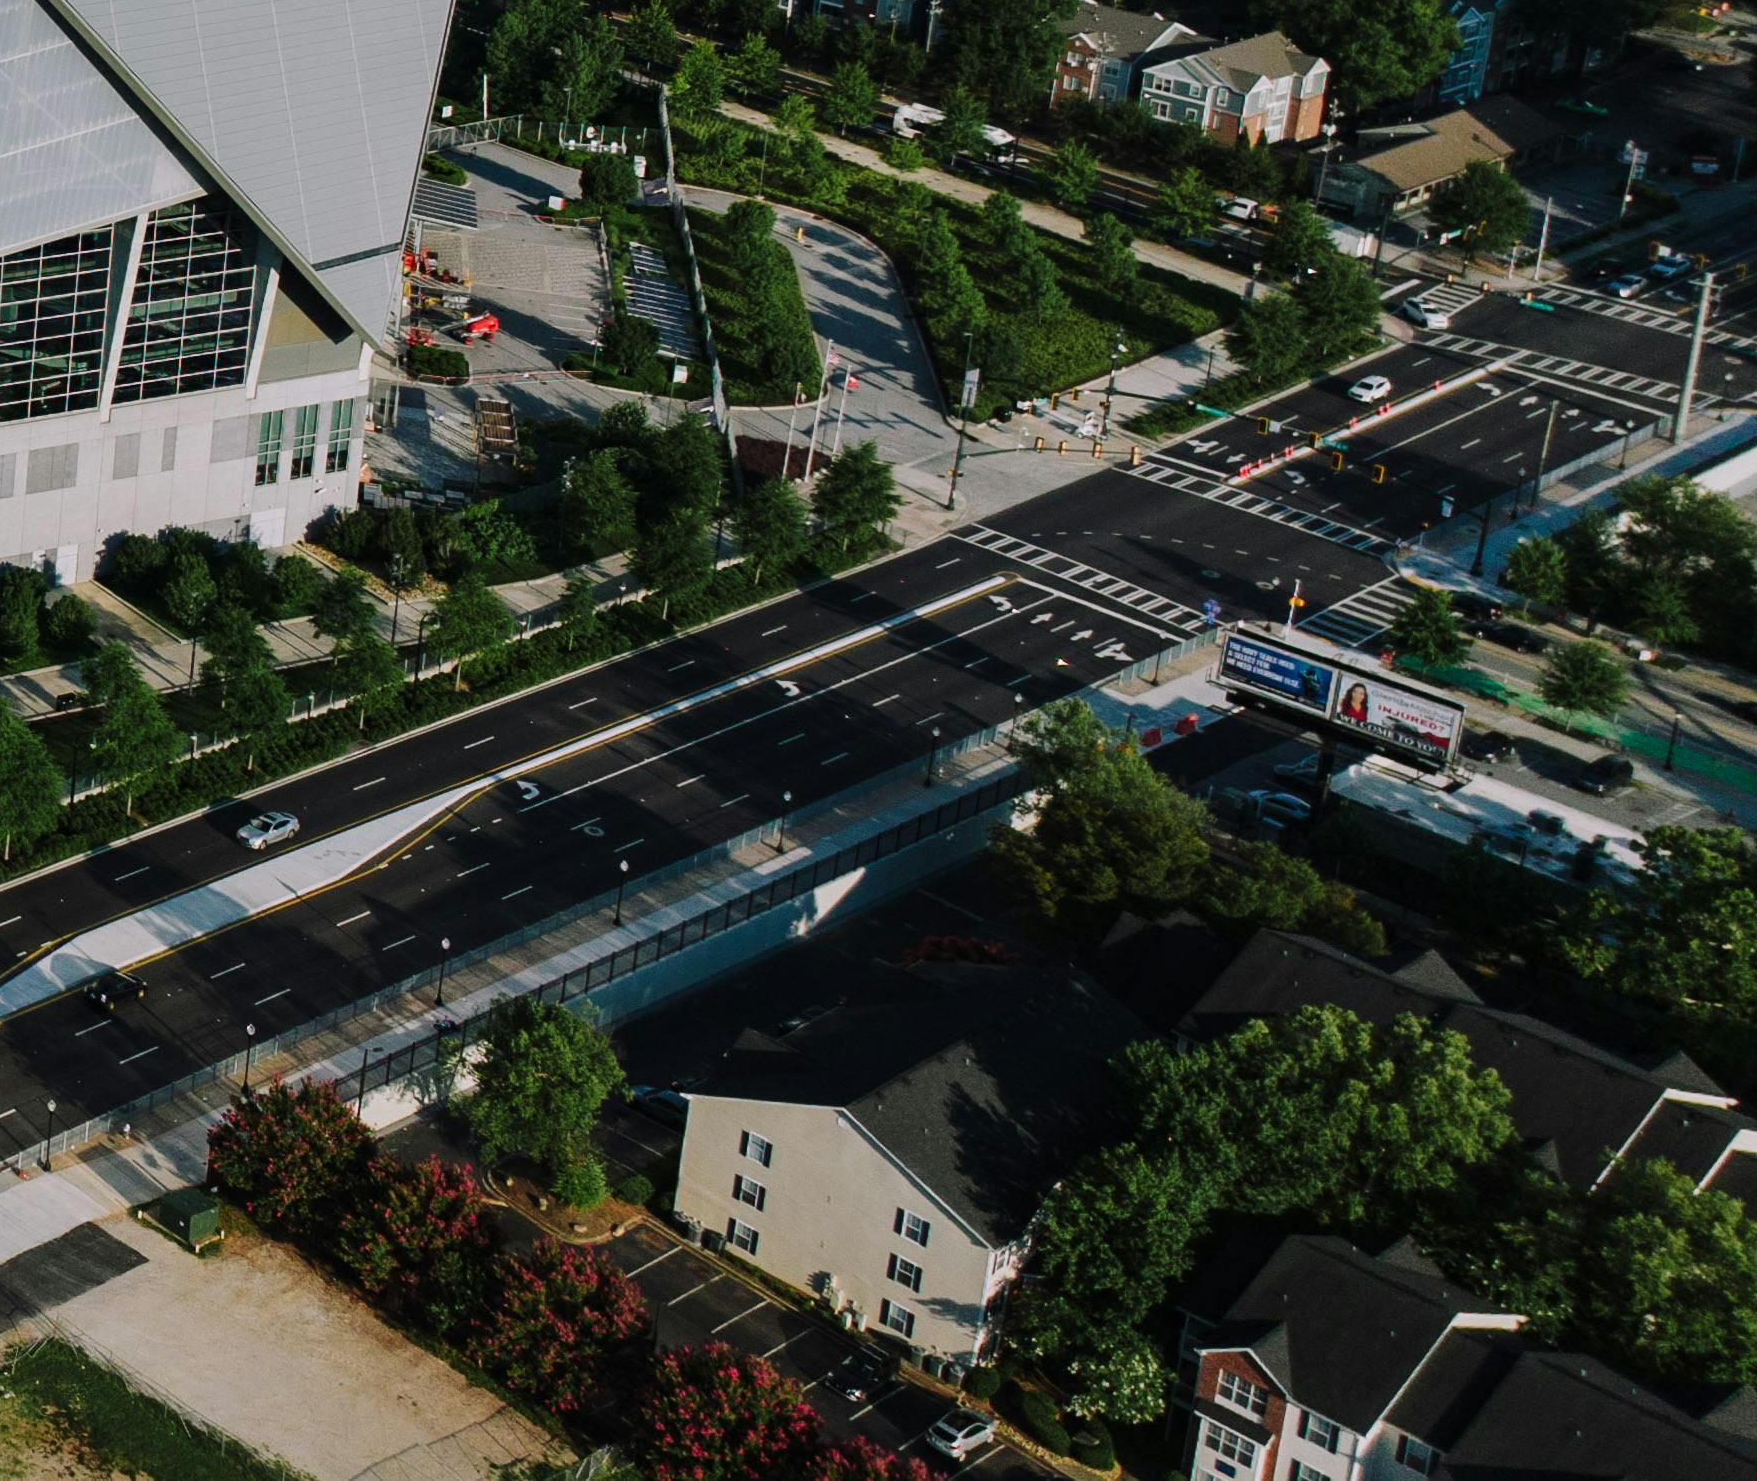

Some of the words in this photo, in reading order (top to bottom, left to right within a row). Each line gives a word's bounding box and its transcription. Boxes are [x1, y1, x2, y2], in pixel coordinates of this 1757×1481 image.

[1377, 703, 1445, 731] INJURED?
[1359, 721, 1394, 739] COME
[1397, 733, 1414, 746] TO
